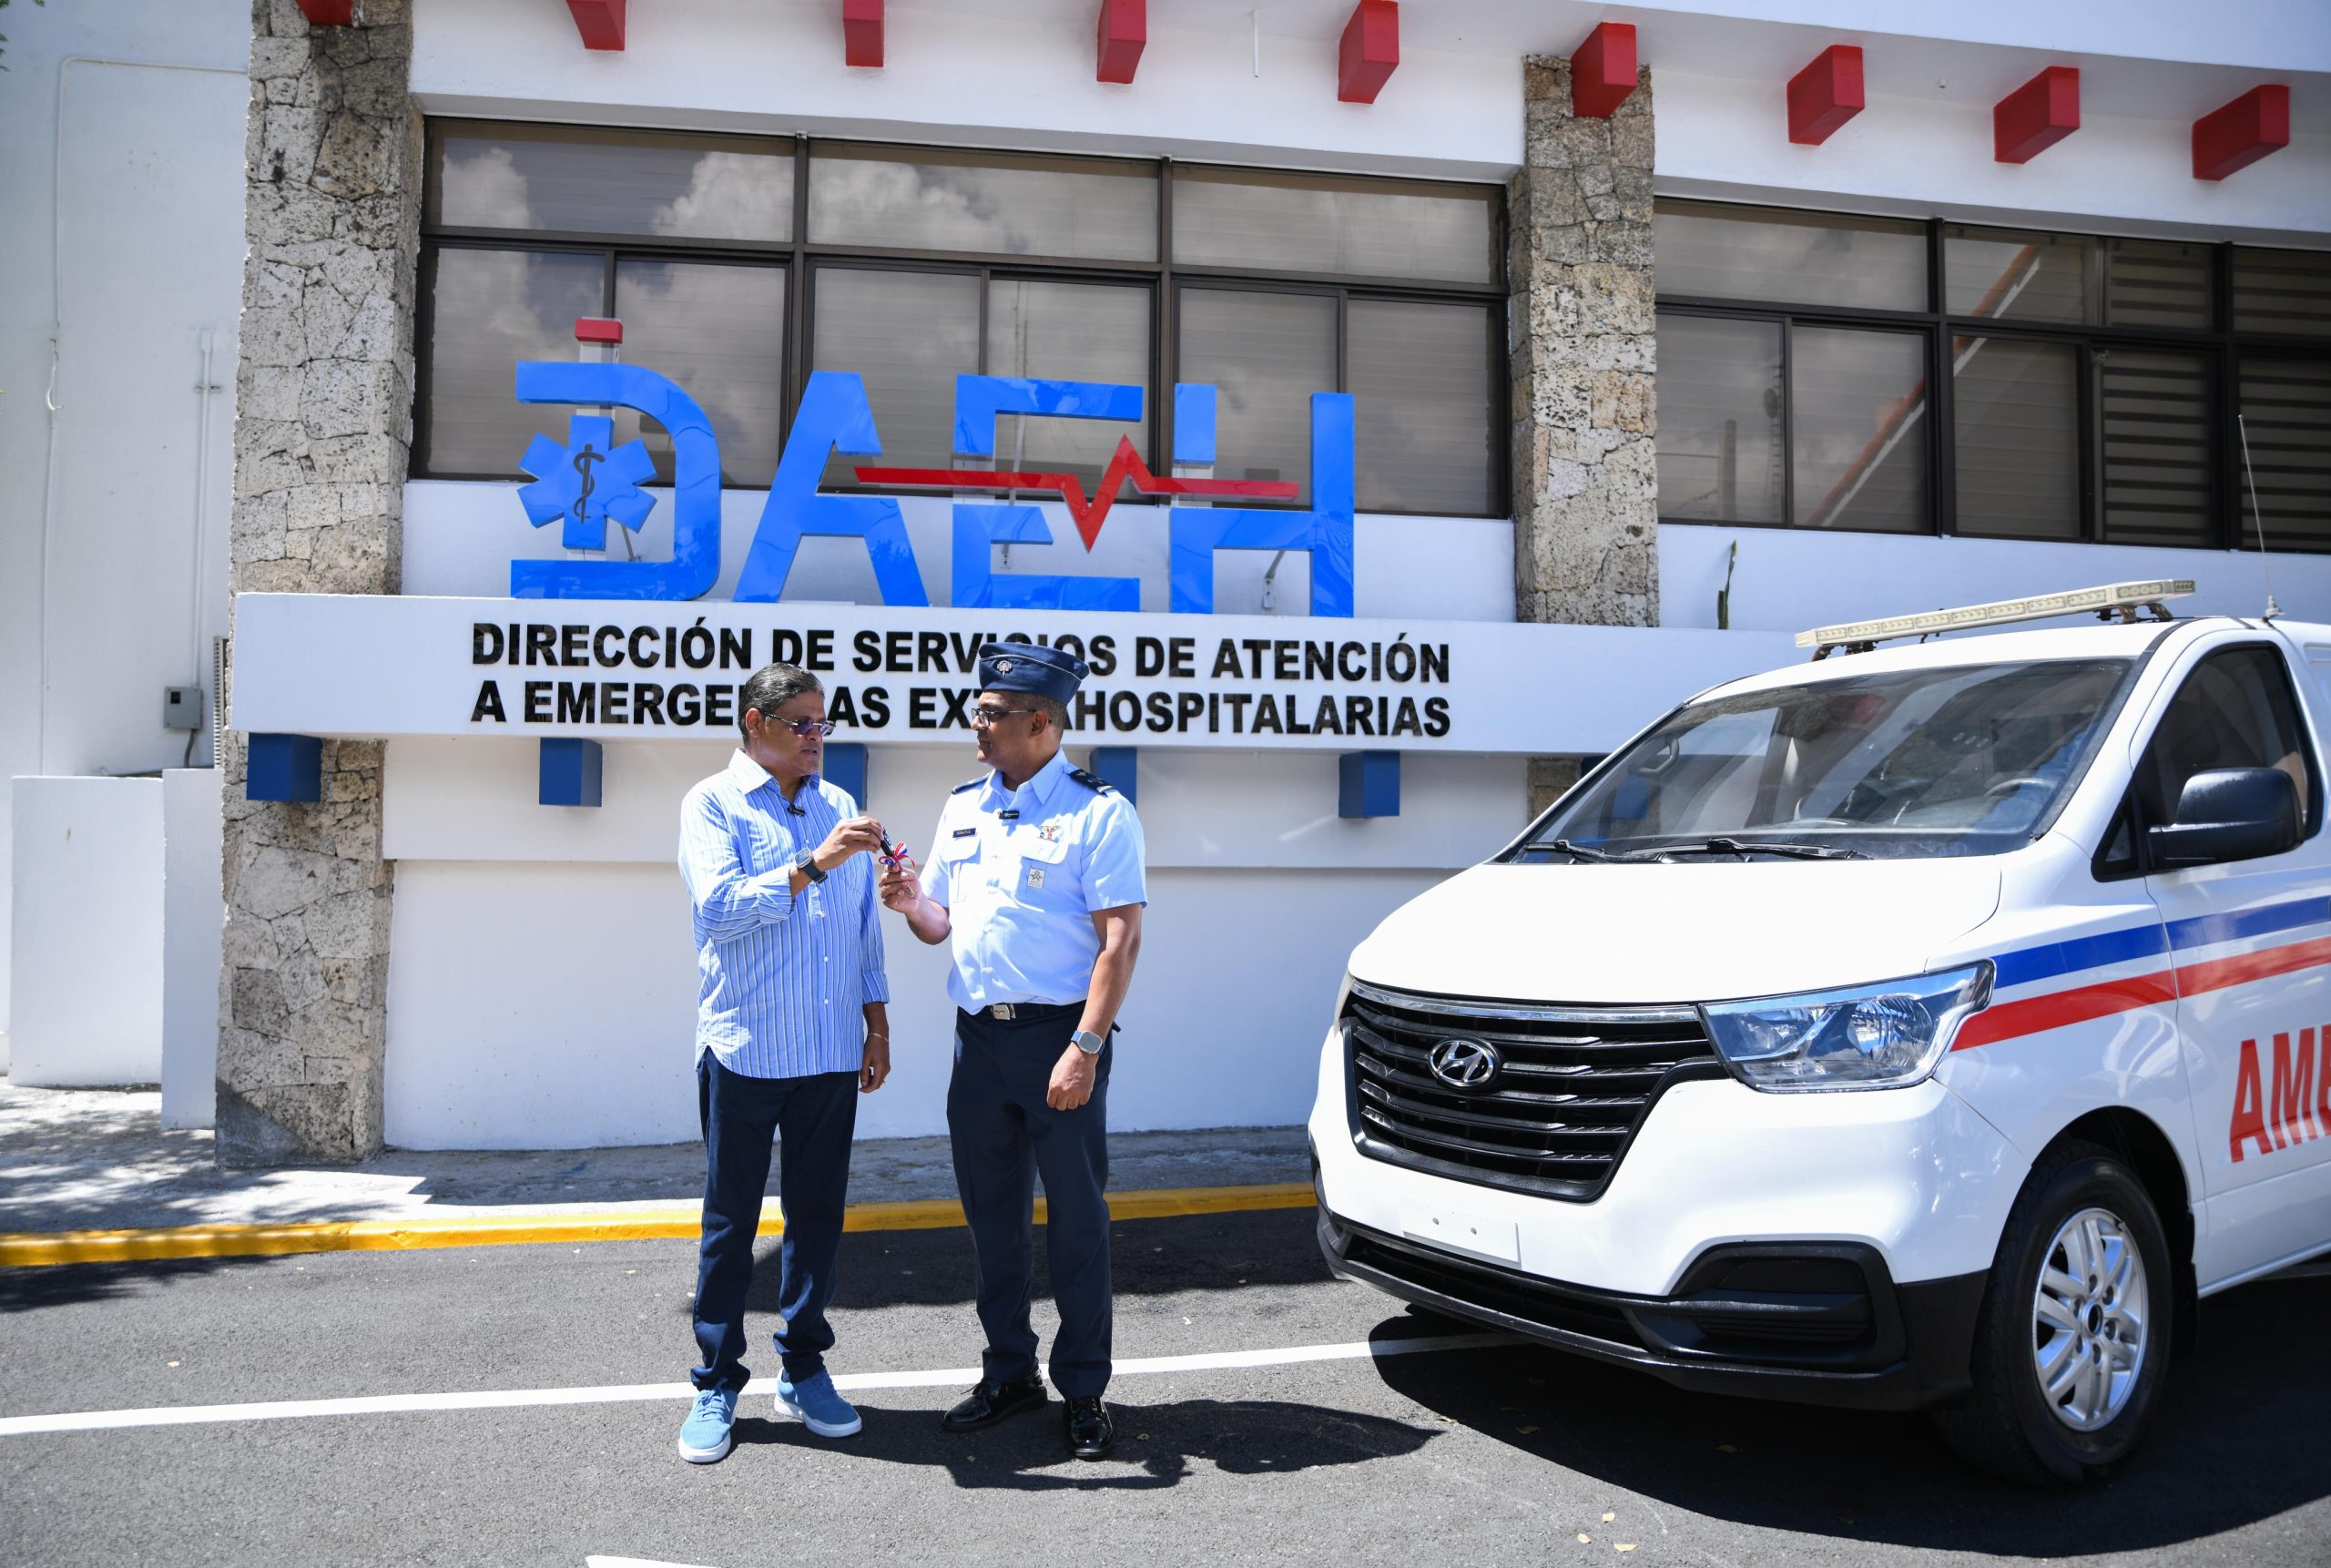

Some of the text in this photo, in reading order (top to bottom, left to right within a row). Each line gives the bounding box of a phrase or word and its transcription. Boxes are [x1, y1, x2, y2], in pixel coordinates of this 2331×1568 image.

[510, 361, 1355, 618] DAEH
[472, 616, 1451, 684] DIRECCIÓN DE SERVOS DE ATENCIÓN
[470, 679, 1451, 738] A EMERGEAS EXHOSPITALARIAS
